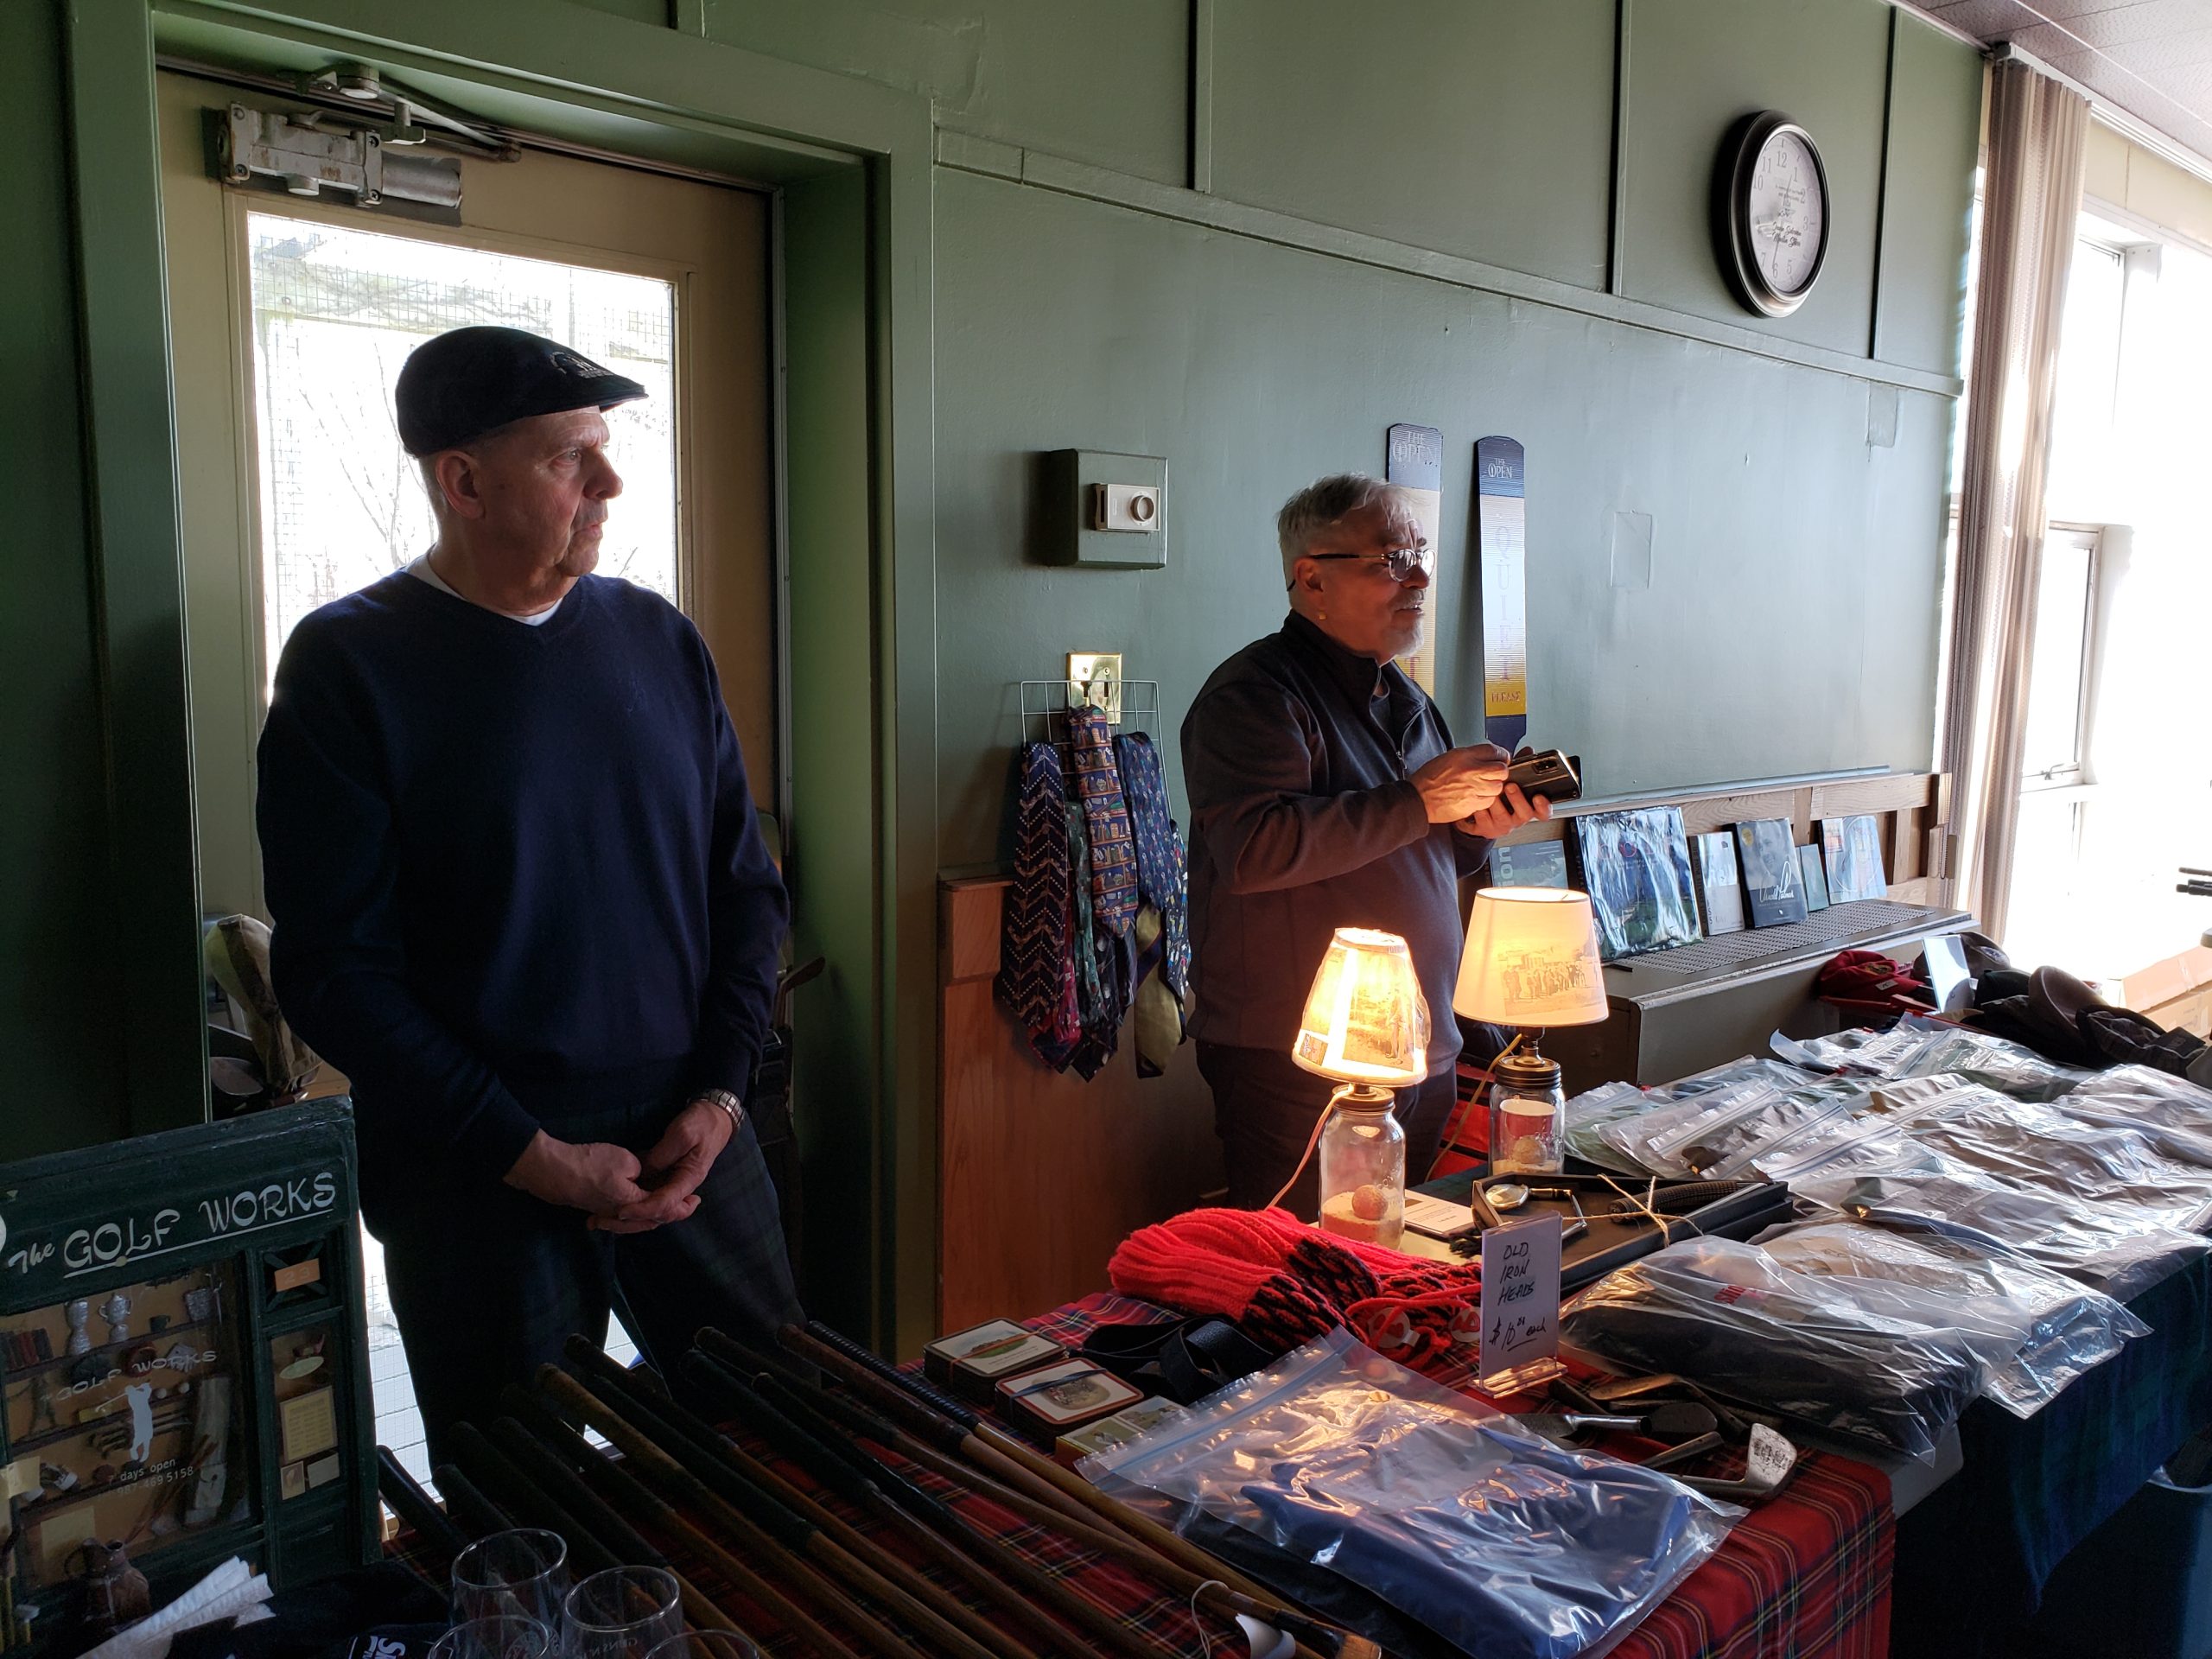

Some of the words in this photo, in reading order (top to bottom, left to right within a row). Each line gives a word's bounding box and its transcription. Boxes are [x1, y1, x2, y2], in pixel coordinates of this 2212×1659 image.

[1762, 156, 1772, 174] 11
[1777, 150, 1787, 168] 12
[1793, 166, 1798, 182] 1
[1800, 188, 1807, 205] 2
[1803, 216, 1809, 232] 3
[1772, 263, 1778, 278] 6
[1392, 441, 1439, 464] OPEN
[1488, 463, 1513, 480] OPEN
[1495, 525, 1512, 681] QUIET
[1491, 690, 1522, 704] PLEASE
[8, 1242, 55, 1274] The
[64, 1209, 180, 1268] GOLF
[199, 1172, 336, 1234] WORKS
[1503, 1242, 1529, 1261] OLD
[1499, 1258, 1530, 1284] IRON
[1497, 1281, 1535, 1306] HEADS
[56, 1369, 122, 1402] GOLF
[132, 1351, 216, 1373] WORKS
[121, 1468, 144, 1482] days
[149, 1459, 175, 1473] open
[167, 1465, 194, 1483] 5158
